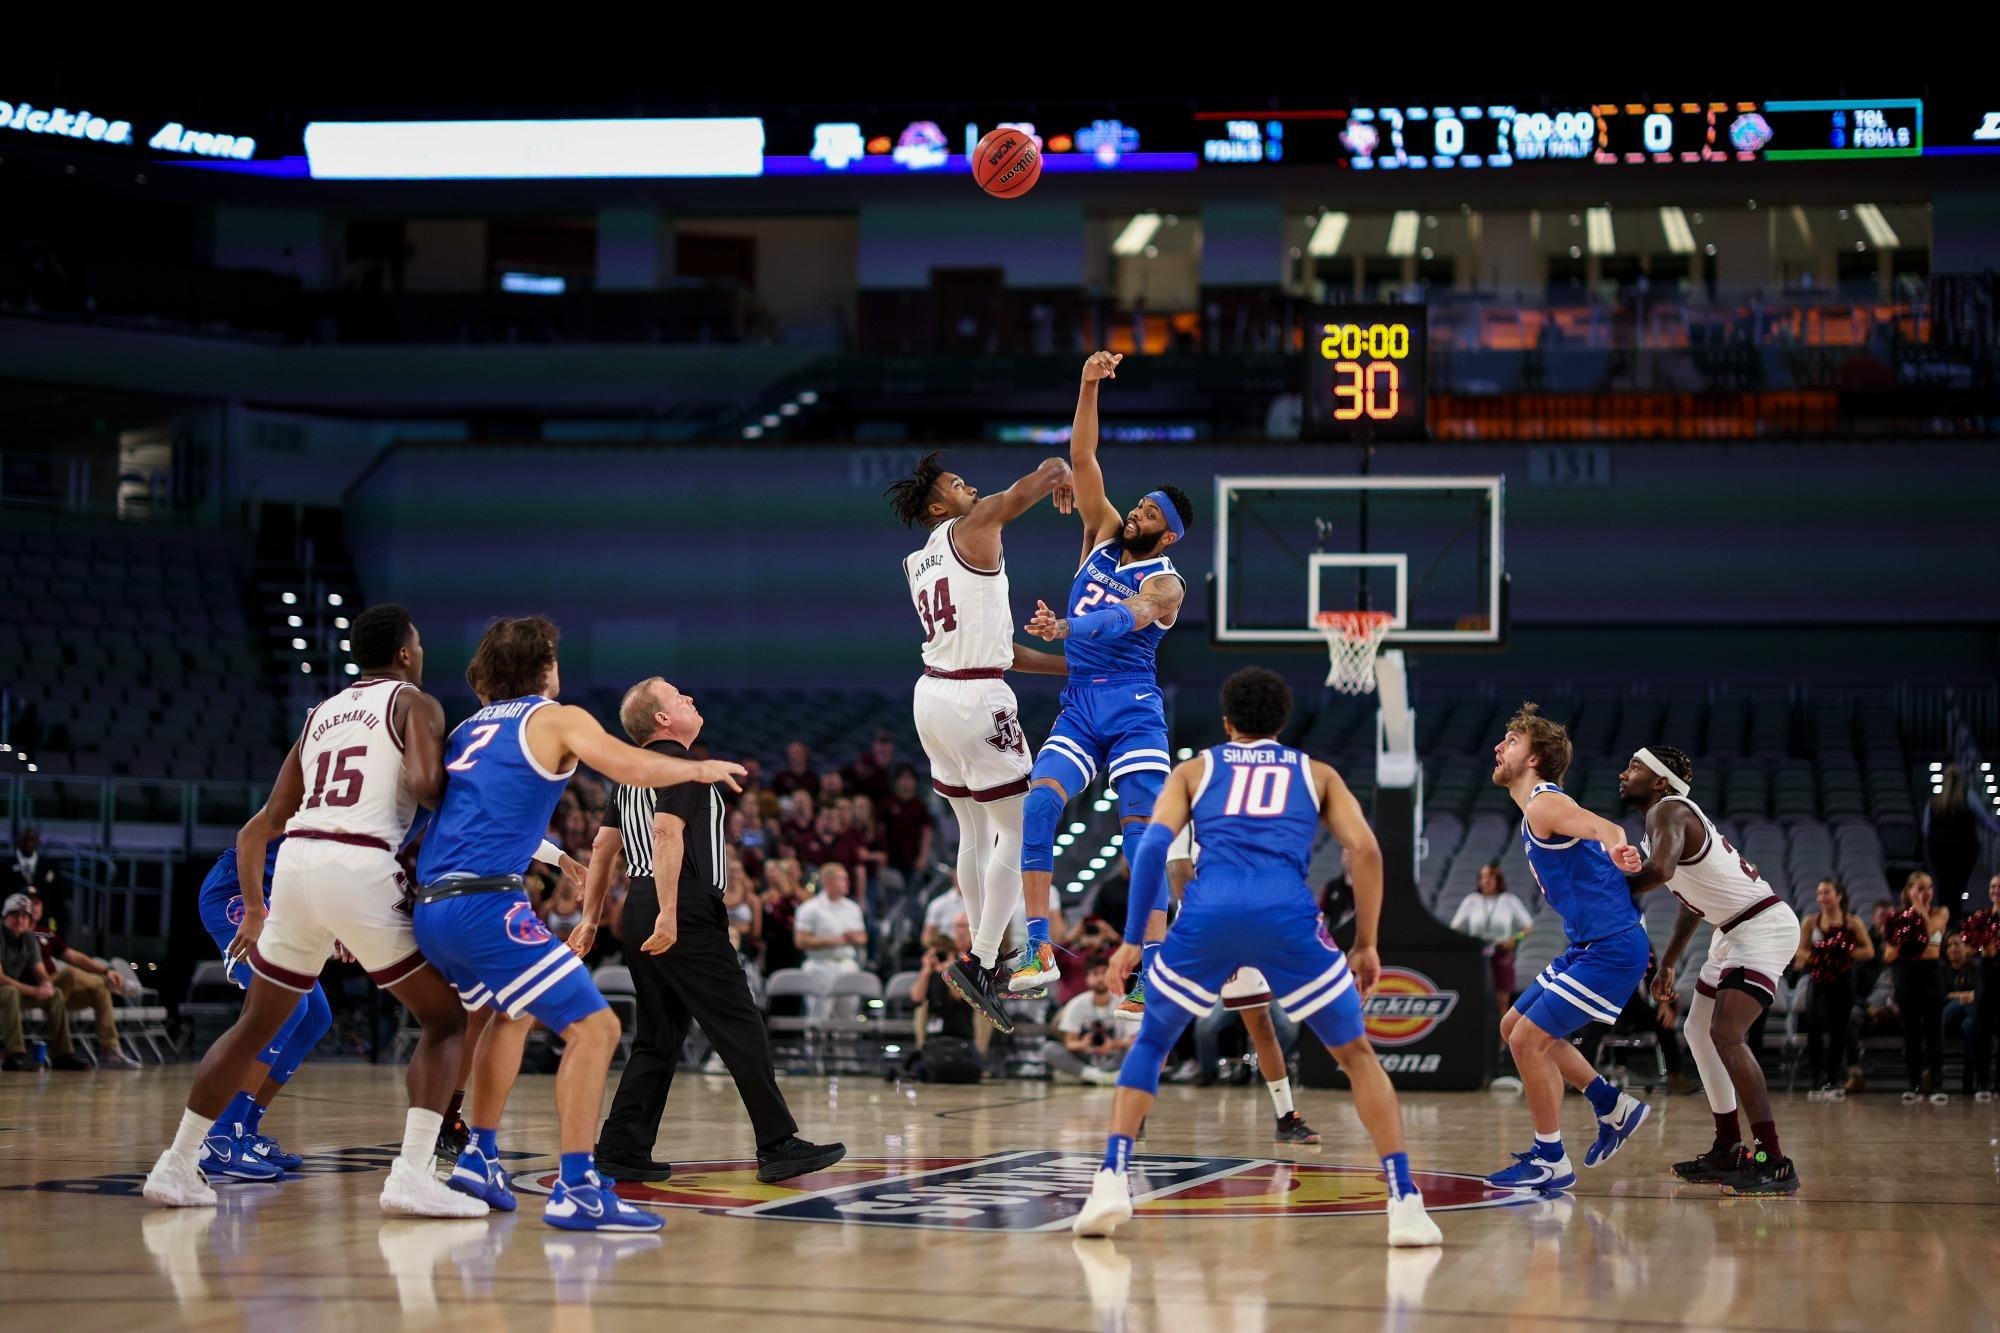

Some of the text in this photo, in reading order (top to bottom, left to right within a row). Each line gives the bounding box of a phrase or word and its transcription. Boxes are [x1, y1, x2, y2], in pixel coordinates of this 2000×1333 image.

[149, 122, 256, 159] Arena
[1435, 117, 1464, 155] 0
[1644, 114, 1672, 152] 0
[1854, 122, 1910, 148] FOULS
[989, 138, 1016, 166] NCAA
[999, 147, 1035, 184] Wilson
[1321, 323, 1409, 359] 20:00
[1333, 361, 1399, 420] 30
[915, 554, 944, 581] MARBLE
[918, 576, 957, 644] 34
[312, 709, 380, 742] COLEMAN III
[446, 722, 501, 771] 2
[1222, 748, 1298, 765] SHAVER JR
[305, 745, 368, 810] 15
[1224, 765, 1291, 816] 10
[1363, 996, 1443, 1015] ickies
[1376, 1053, 1442, 1073] ena
